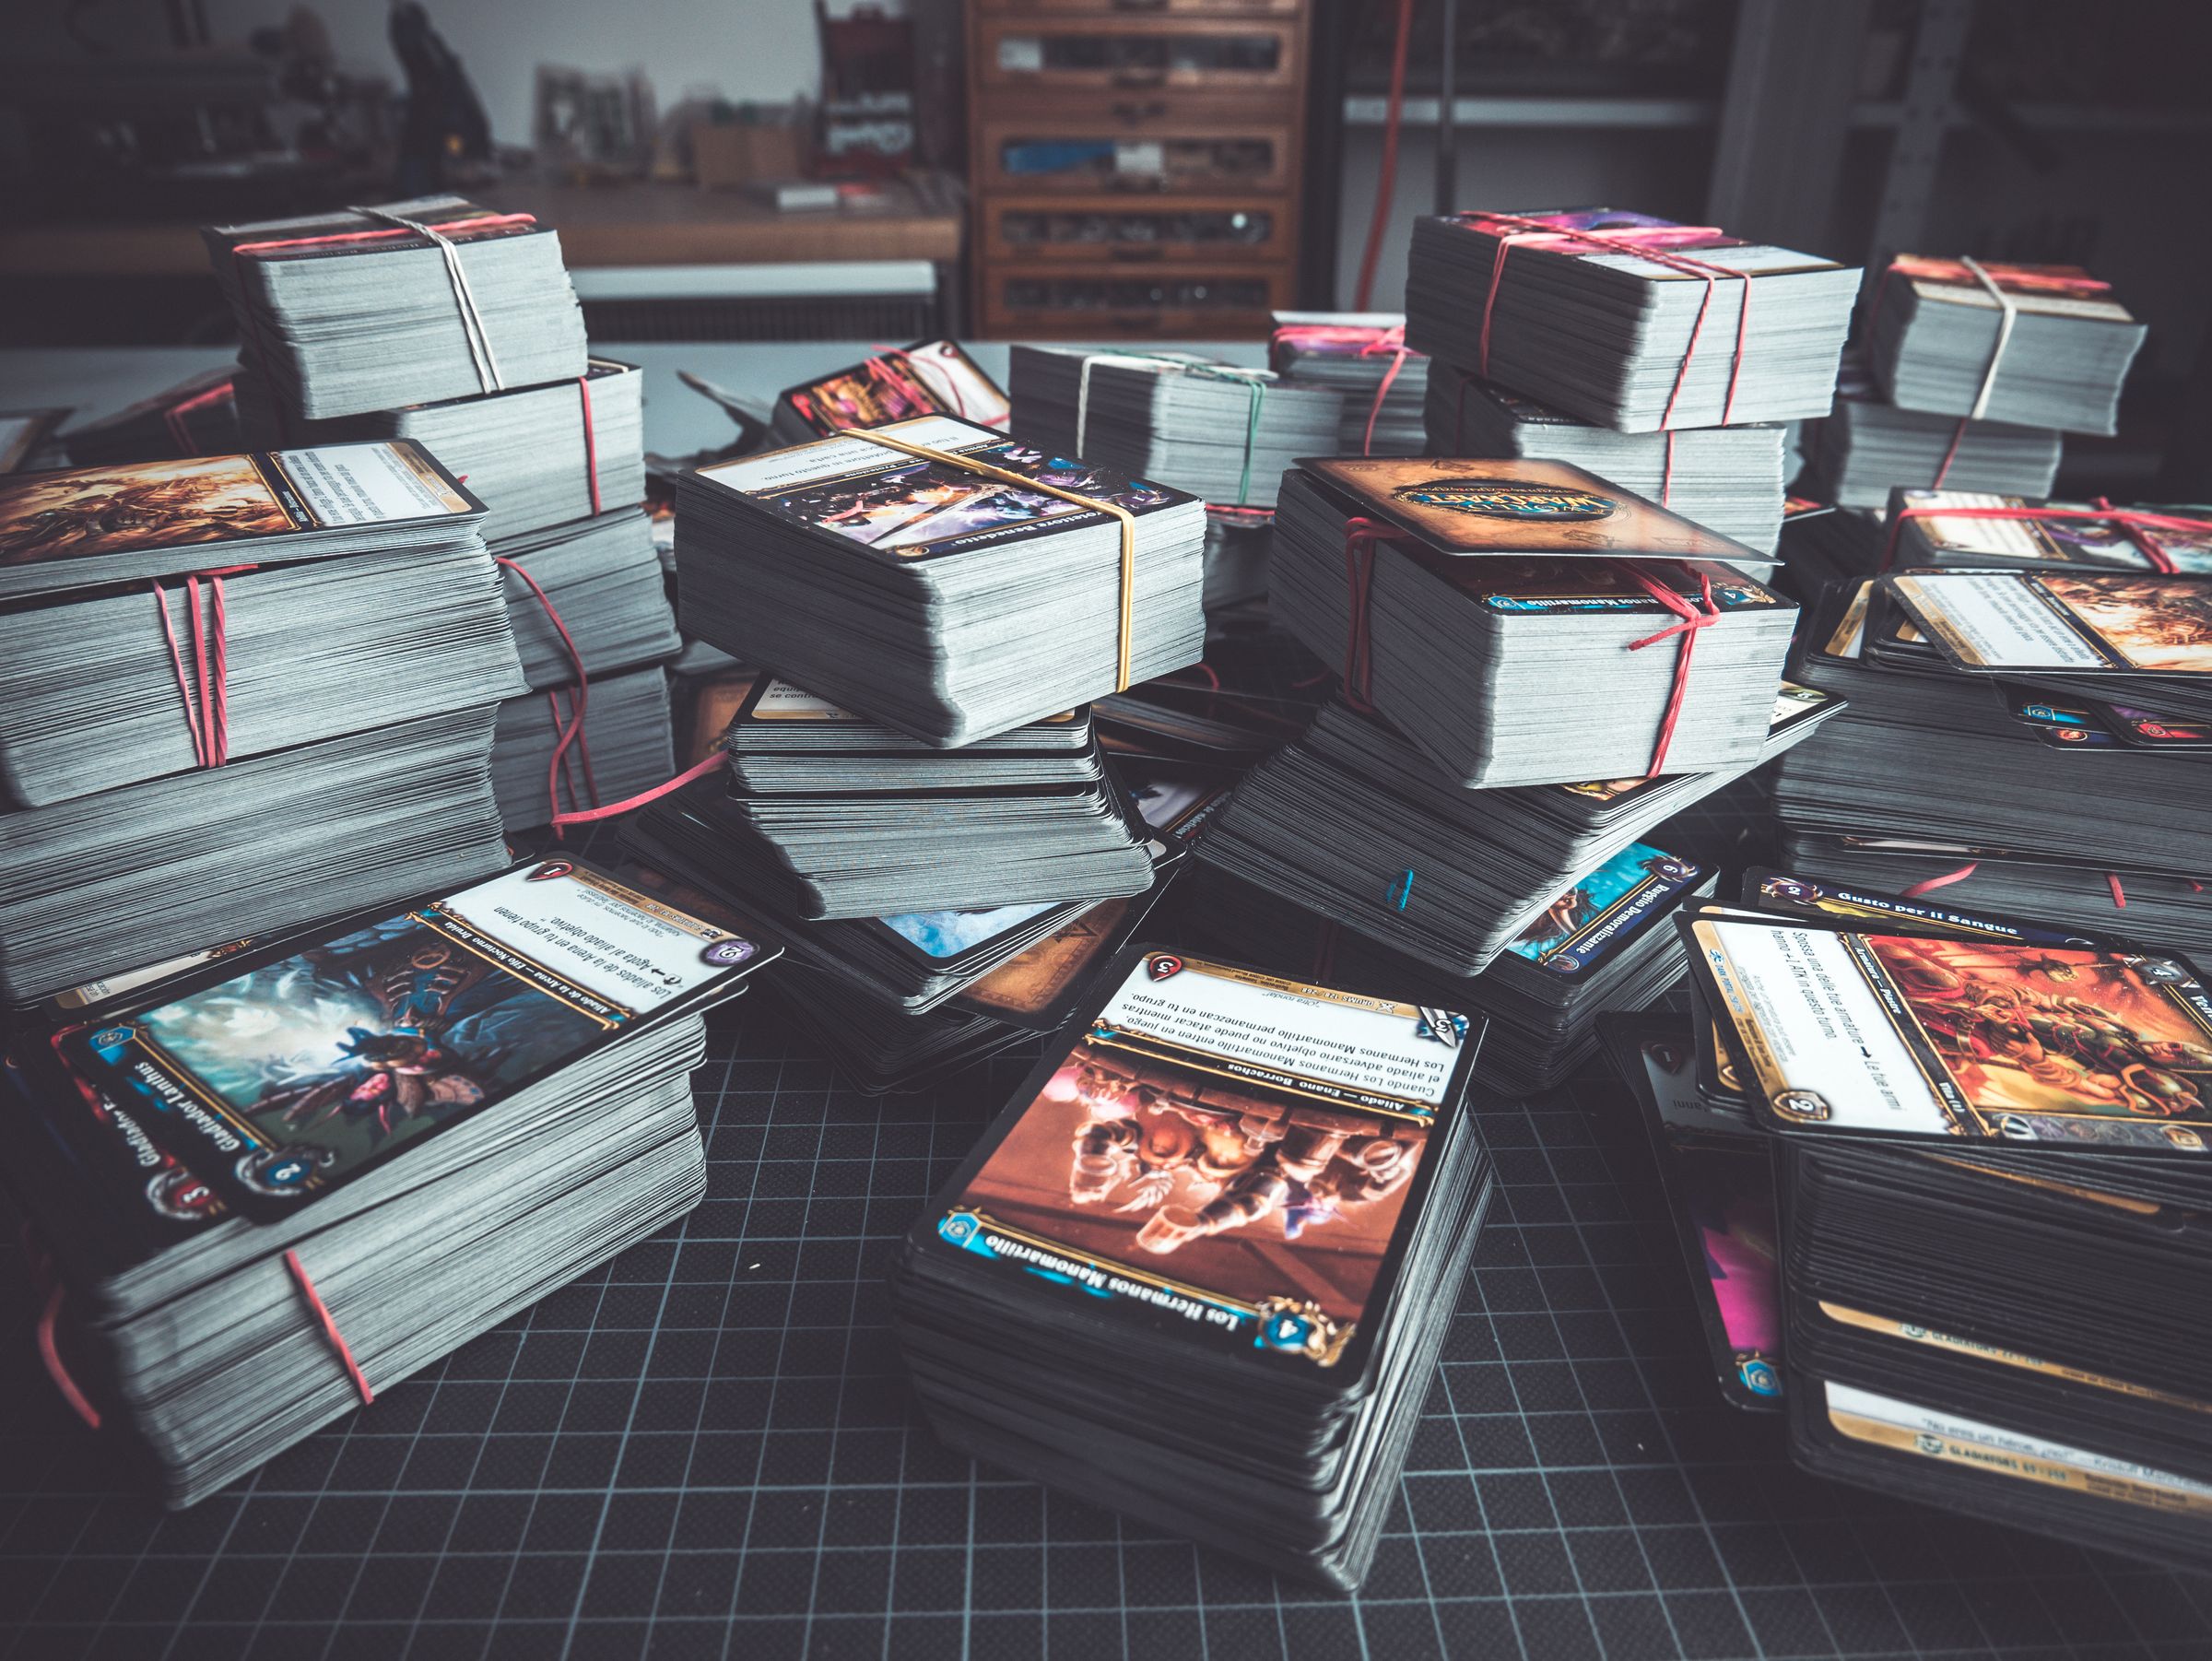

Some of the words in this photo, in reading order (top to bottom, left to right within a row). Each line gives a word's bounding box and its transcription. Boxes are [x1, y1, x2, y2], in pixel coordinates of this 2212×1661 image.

[1418, 492, 1609, 508] WARCRAFT
[1037, 512, 1101, 527] rotettore
[955, 525, 1037, 544] Benedetto
[1526, 599, 1619, 607] Manomartillo
[543, 866, 562, 876] 1
[1635, 884, 1670, 907] Ruggito
[494, 907, 524, 924] tienen
[1786, 885, 1800, 895] 2
[1838, 892, 1889, 908] Gusto
[1895, 905, 1925, 915] per
[1930, 911, 1944, 920] il
[1948, 915, 2017, 935] Sangue
[444, 922, 473, 938] Druida
[519, 921, 550, 935] grupo
[1576, 906, 1642, 954] Demoralizzante
[543, 932, 559, 943] tu
[554, 938, 571, 948] en
[583, 935, 616, 950] aliado
[1771, 930, 1791, 951] hanno
[1793, 932, 1815, 956] Spossa
[472, 937, 510, 960] Nocturno
[567, 945, 596, 961] Arena
[607, 948, 627, 957] al
[719, 944, 745, 958] 2
[507, 957, 527, 970] Elfo
[592, 957, 607, 968] la
[622, 954, 653, 970] Agota
[1784, 953, 1800, 962] +1
[1807, 958, 1823, 972] una
[602, 962, 620, 973] de
[1158, 961, 1173, 973] 3
[1789, 965, 1806, 978] ATK
[534, 972, 561, 987] Arena
[616, 970, 654, 988] aliados
[1796, 979, 1812, 988] in
[1816, 973, 1834, 991] delle
[1854, 948, 1879, 979] Armatura
[1880, 988, 1901, 1014] Piastre
[558, 984, 571, 994] la
[568, 990, 582, 999] de
[650, 985, 673, 1000] Los
[580, 996, 610, 1014] Aliado
[1132, 994, 1166, 1007] grupo.
[1341, 995, 1374, 1006] DRUMS
[1801, 989, 1825, 1015] questo
[1827, 993, 1842, 1006] tue
[1122, 1004, 1171, 1020] mientras
[1166, 1002, 1180, 1013] tu
[1182, 1007, 1197, 1015] en
[1126, 1016, 1159, 1030] juego,
[1174, 1018, 1212, 1031] atacar
[1199, 1011, 1276, 1034] permanezcan
[1432, 1017, 1451, 1032] 3
[1817, 1017, 1837, 1039] turno.
[1834, 1007, 1865, 1043] armature
[1160, 1026, 1176, 1035] en
[1178, 1031, 1215, 1044] entren
[1215, 1028, 1250, 1041] puede
[1252, 1036, 1267, 1045] no
[1278, 1031, 1356, 1054] Manomartillo
[1218, 1042, 1295, 1066] Manomartillo
[1270, 1042, 1316, 1056] objetivo
[1320, 1053, 1382, 1070] adversario
[1360, 1048, 1419, 1067] Hermanos
[1300, 1061, 1359, 1081] Hermanos
[1423, 1061, 1445, 1073] Los
[1864, 1061, 1879, 1070] Le
[1228, 1064, 1293, 1086] Borrachos
[1364, 1075, 1383, 1087] Los
[1386, 1067, 1425, 1080] aliado
[1427, 1074, 1441, 1084] el
[1871, 1073, 1888, 1087] tue
[135, 1062, 184, 1103] Lanthus
[1300, 1081, 1340, 1097] Enano
[1387, 1080, 1435, 1097] Cuando
[1939, 1082, 1955, 1099] Vita
[1360, 1096, 1404, 1111] Aliado
[1789, 1098, 1814, 1111] 2
[1878, 1089, 1906, 1111] armi
[177, 1101, 241, 1151] Gladiador
[113, 1111, 160, 1166] Gladiador
[275, 1162, 301, 1181] 2
[978, 1235, 1107, 1288] Manomartillo
[1108, 1278, 1208, 1320] Hermanos
[1206, 1303, 1243, 1330] Los
[1278, 1319, 1299, 1345] 4
